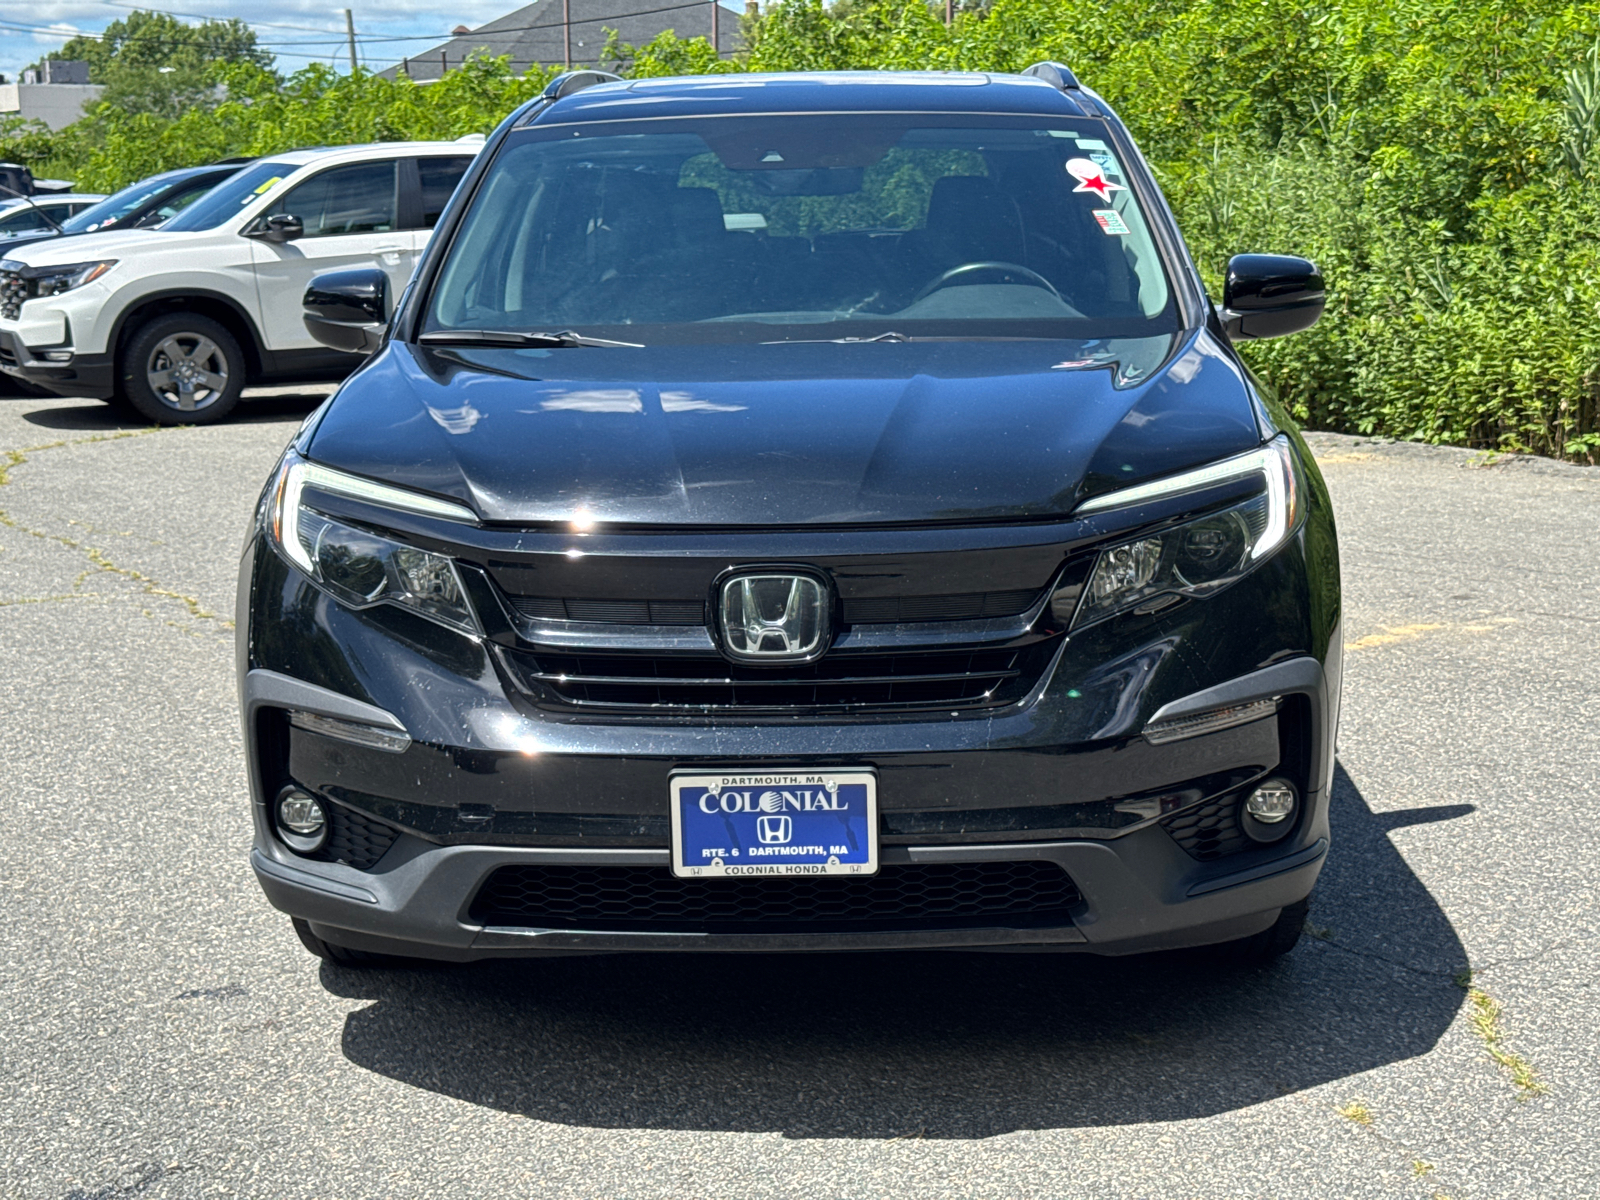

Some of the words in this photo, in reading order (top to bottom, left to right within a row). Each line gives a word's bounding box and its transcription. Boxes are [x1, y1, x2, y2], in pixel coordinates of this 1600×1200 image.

[806, 776, 824, 784] MA
[702, 849, 729, 858] RTE.
[731, 848, 740, 857] 6
[749, 846, 827, 856] DARTMOUTH,
[830, 845, 848, 855] MA
[724, 865, 782, 875] COLONIAL
[785, 865, 827, 874] HONDA
